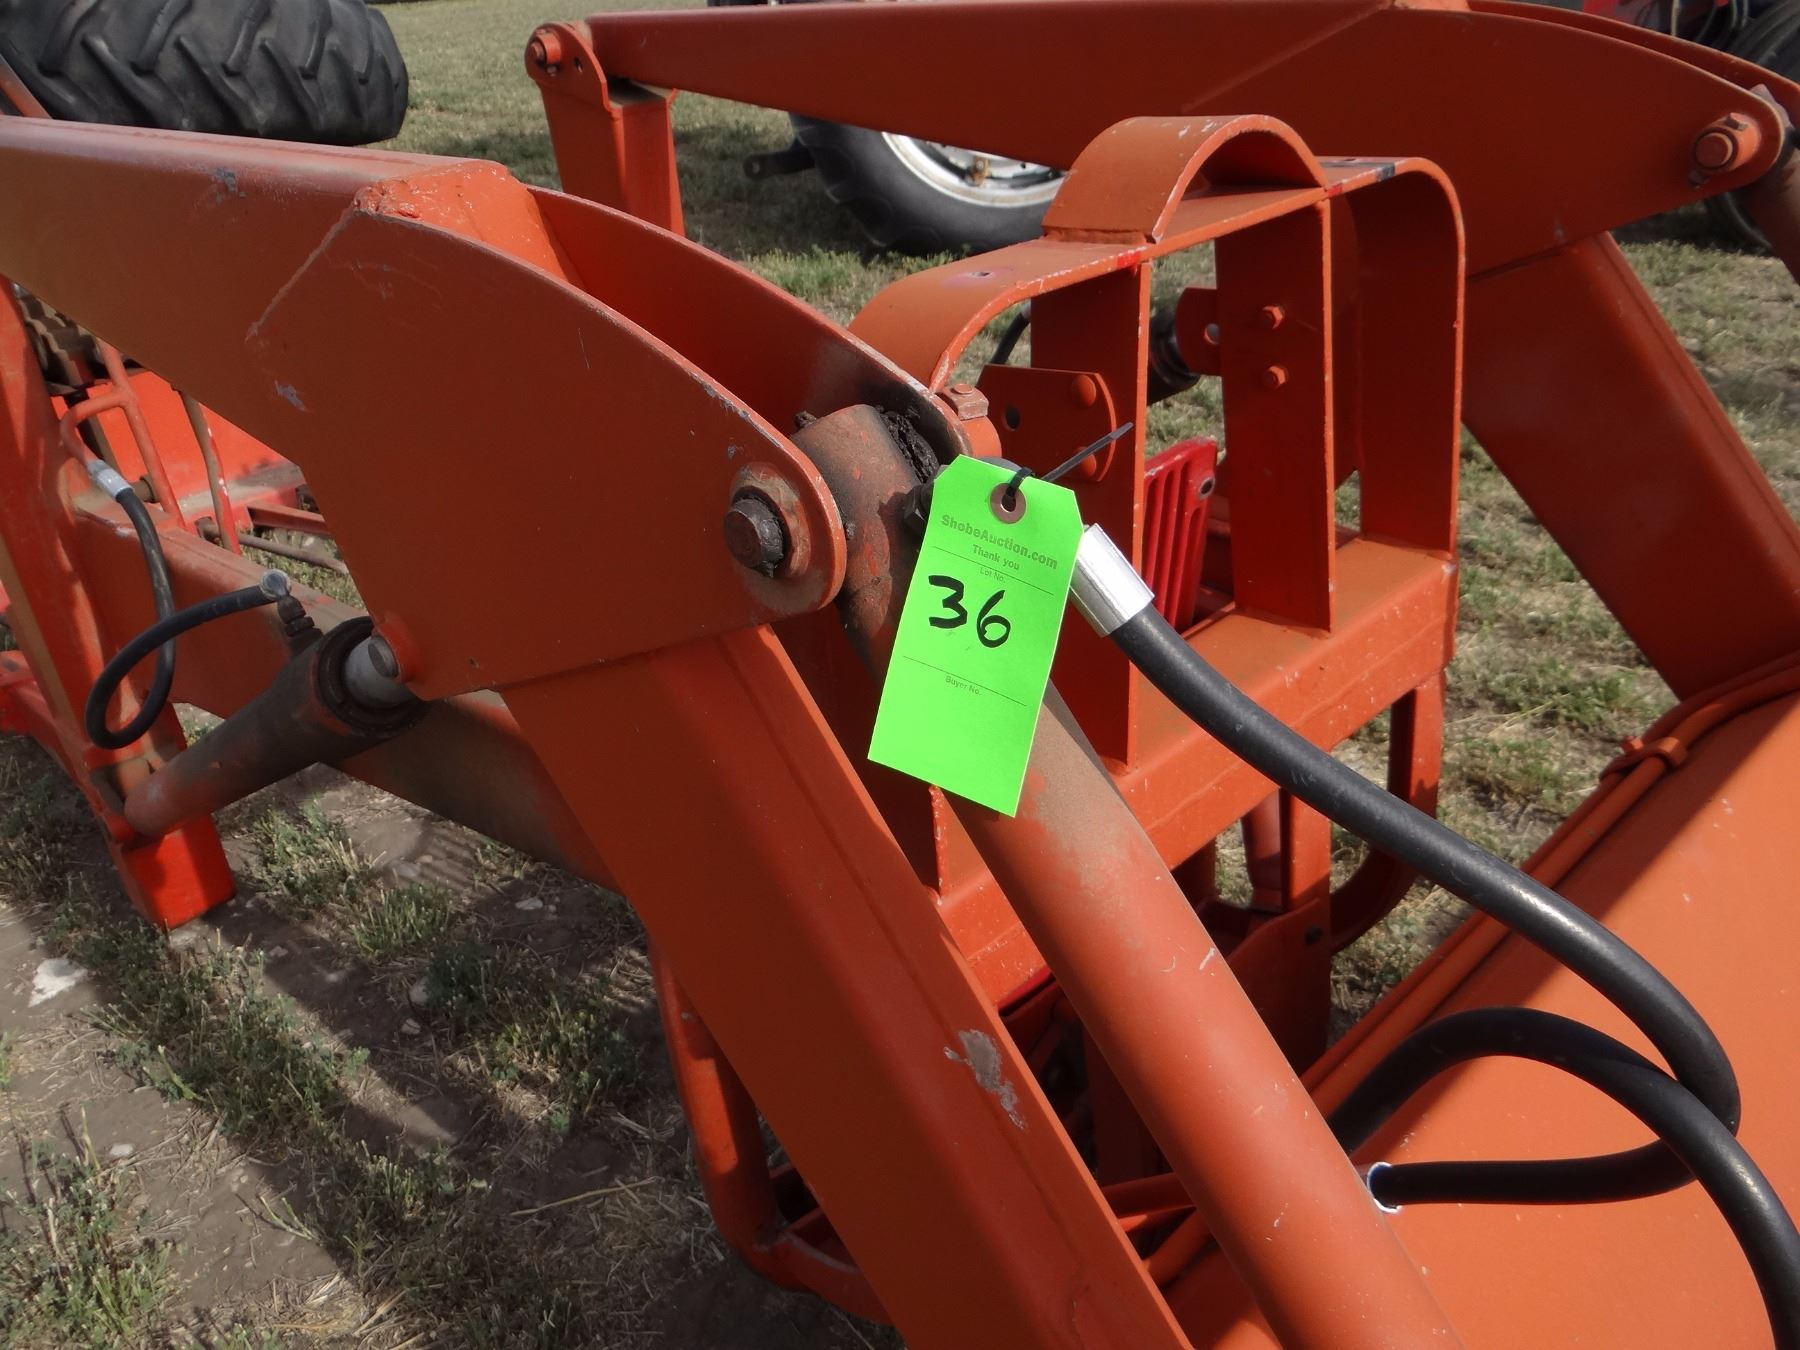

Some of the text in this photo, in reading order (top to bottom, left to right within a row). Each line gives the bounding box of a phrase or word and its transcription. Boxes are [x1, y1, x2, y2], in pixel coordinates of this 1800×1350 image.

[941, 515, 1058, 569] ShobeAuction.com
[972, 544, 1020, 571] Thank you
[980, 567, 1006, 583] Lot No.
[928, 574, 1011, 648] 36
[945, 675, 981, 695] Buyer No.
